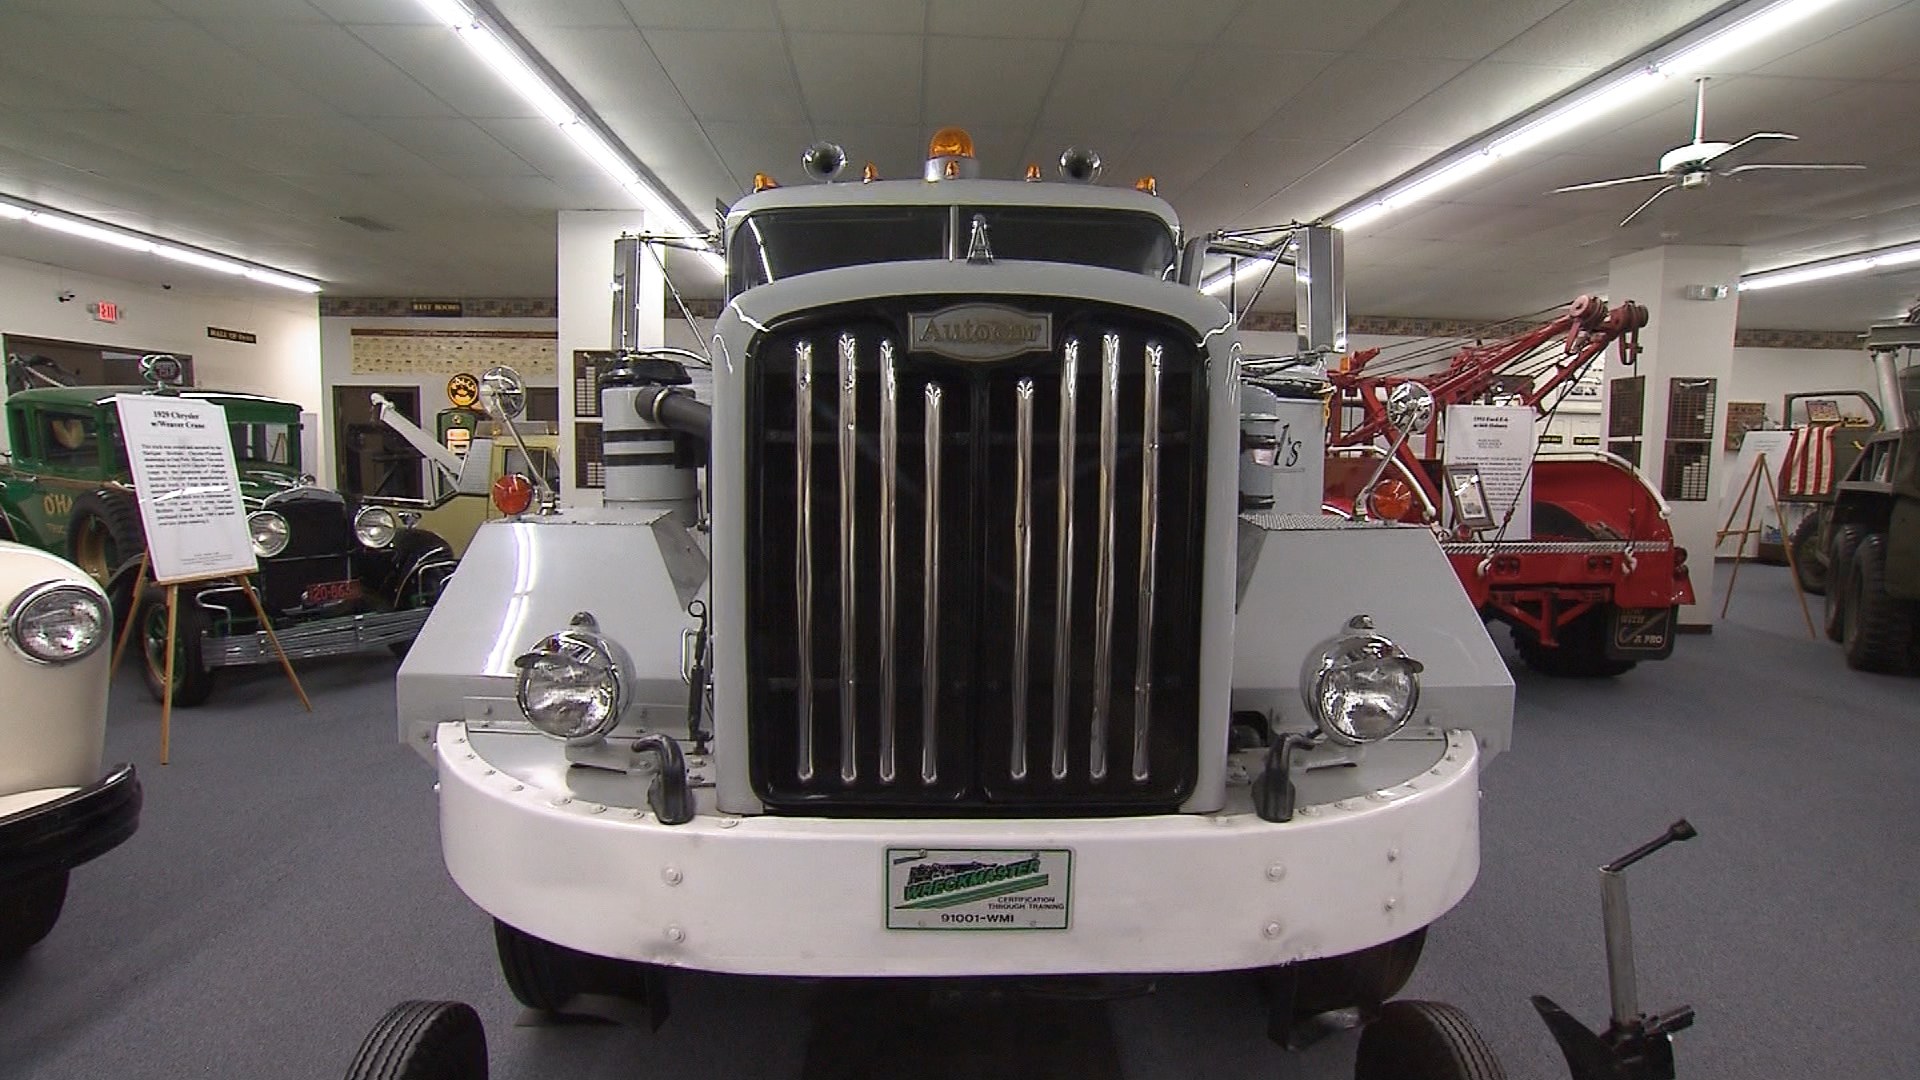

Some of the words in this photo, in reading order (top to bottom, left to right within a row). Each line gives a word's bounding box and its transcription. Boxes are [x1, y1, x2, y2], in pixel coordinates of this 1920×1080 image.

[918, 318, 1041, 343] Autocar
[904, 858, 1041, 901] WRECKMASTER
[997, 896, 1056, 904] CERTIFICATION
[940, 913, 1014, 923] 91001-WMI
